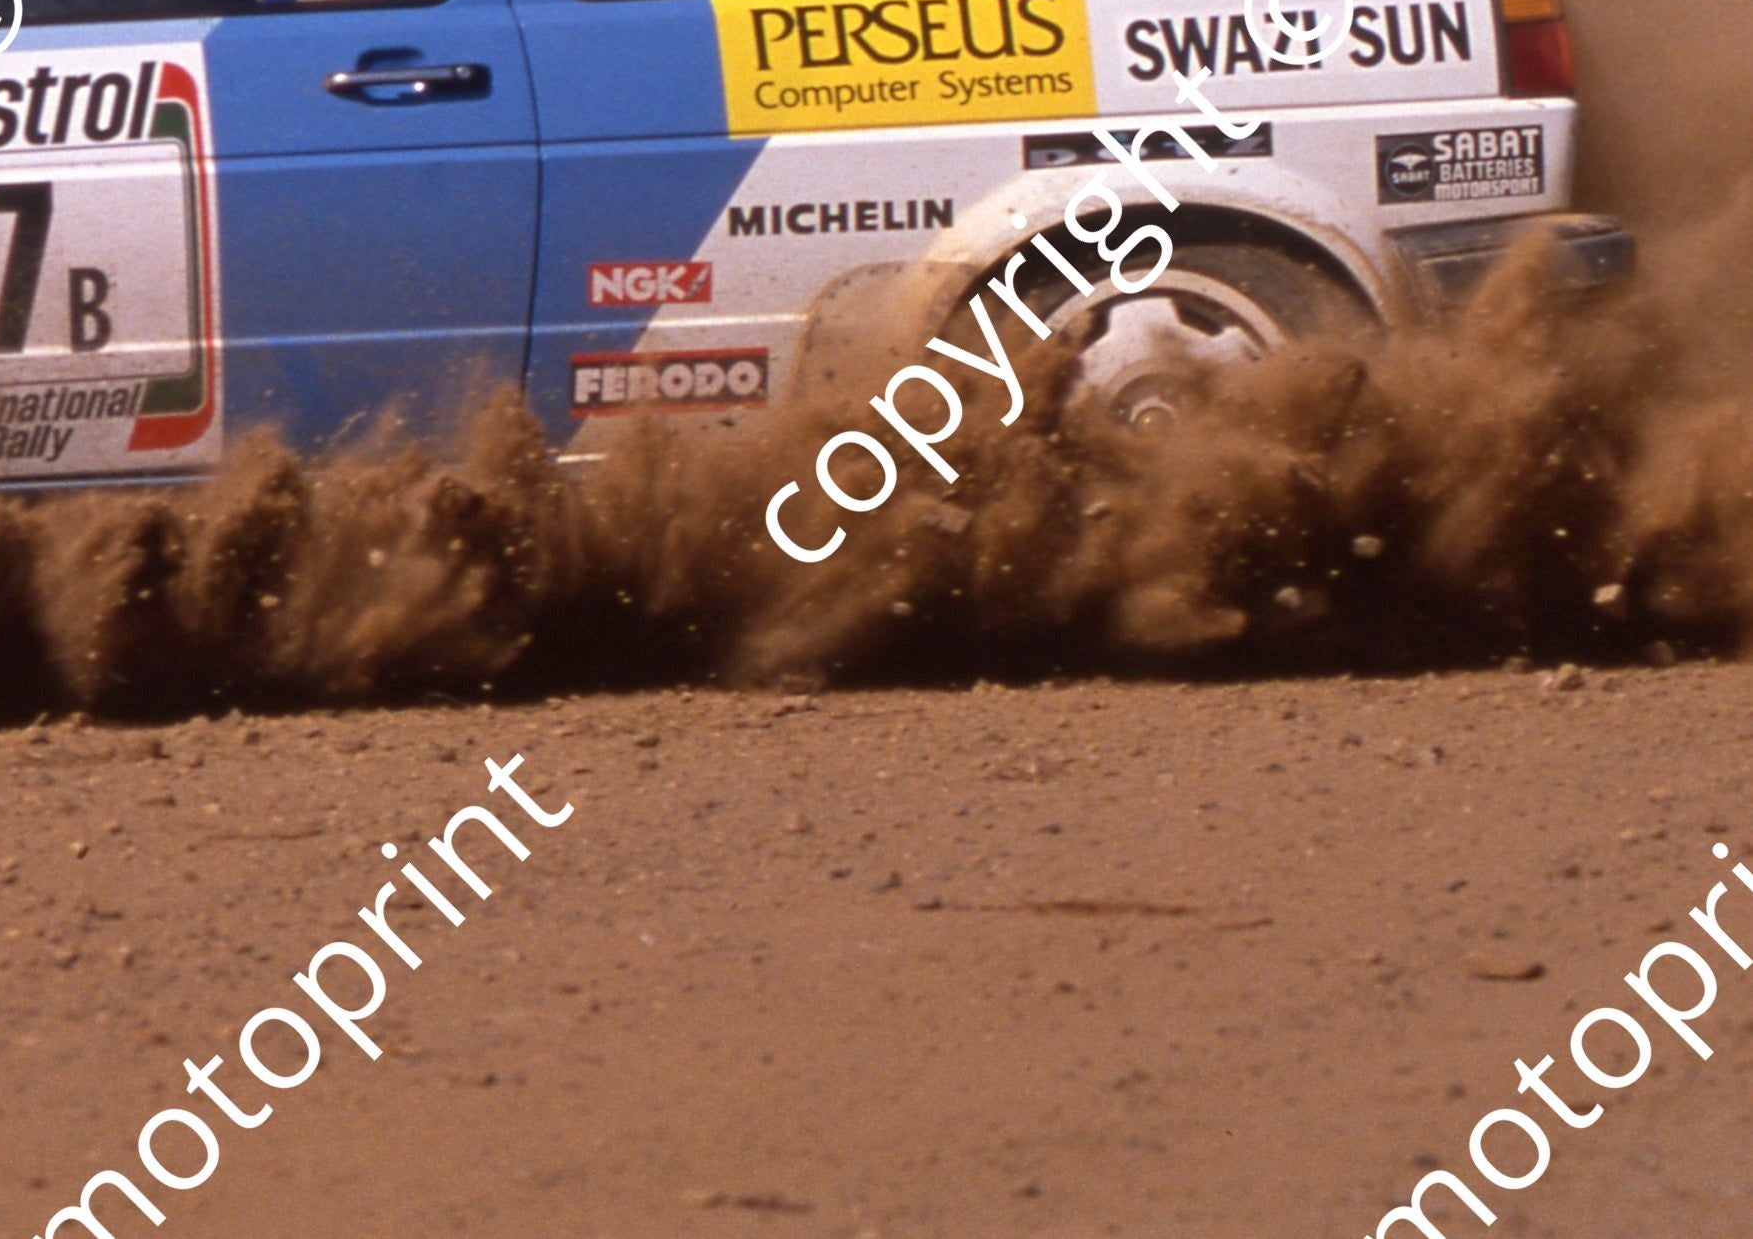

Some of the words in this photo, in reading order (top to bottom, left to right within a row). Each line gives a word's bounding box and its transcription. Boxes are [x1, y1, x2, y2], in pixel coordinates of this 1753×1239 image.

[1125, 9, 1322, 82] SWAZI
[1348, 1, 1472, 68] SUN
[754, 77, 920, 112] Computer
[938, 70, 1073, 105] Systems
[1433, 128, 1540, 162] SABAT
[1391, 169, 1431, 185] SABAT
[1434, 177, 1539, 201] MOTORSPORT
[1439, 158, 1535, 183] BATTERIES
[728, 198, 955, 237] MICHELIN
[591, 265, 688, 304] NGK
[68, 267, 113, 354] B
[573, 360, 762, 404] FERODO
